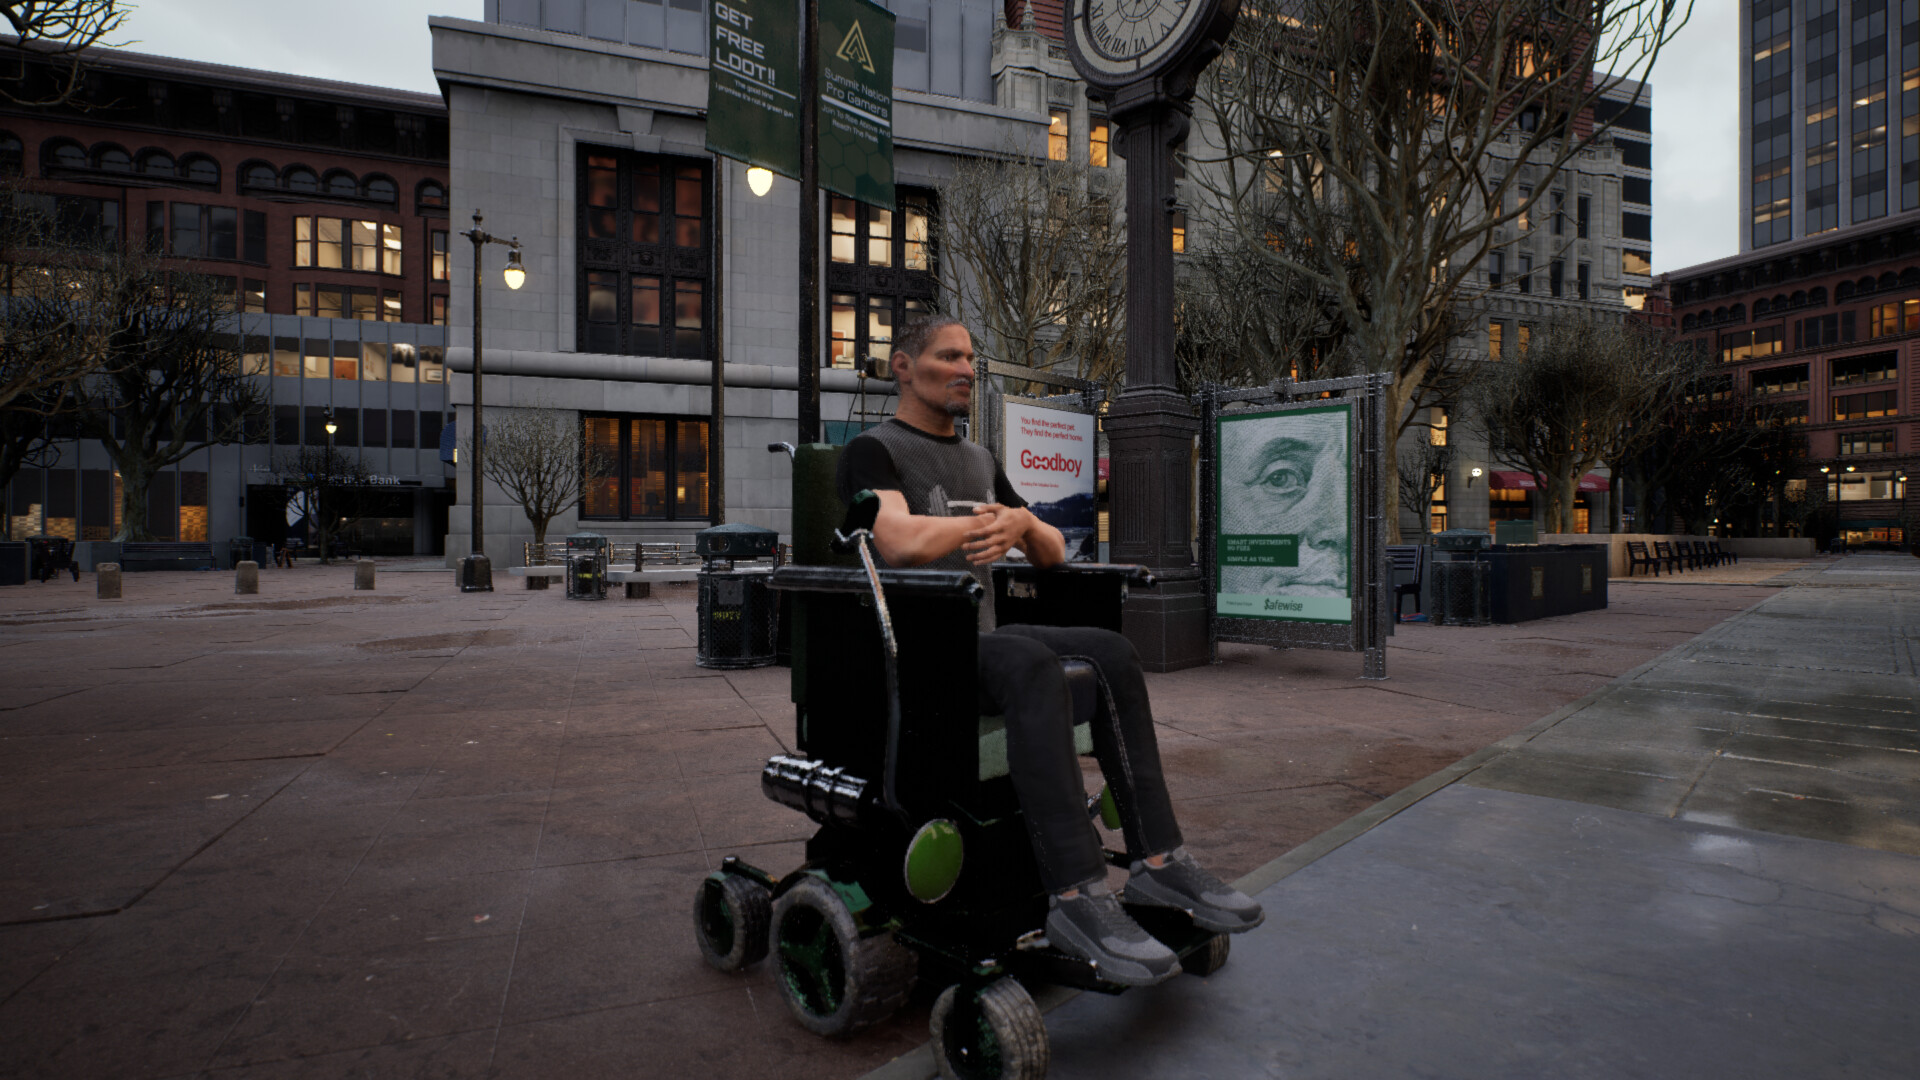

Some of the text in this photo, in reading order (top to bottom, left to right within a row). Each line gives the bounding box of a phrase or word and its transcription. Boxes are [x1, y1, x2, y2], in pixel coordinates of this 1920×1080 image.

[715, 1, 753, 30] GET
[716, 24, 765, 60] FREE
[716, 47, 775, 86] LOOT!!
[824, 67, 890, 104] Summit Nation
[826, 81, 888, 118] Pro Gamers
[821, 104, 836, 116] Join
[879, 127, 891, 139] And
[832, 118, 852, 133] Reach
[1020, 416, 1031, 425] You
[1031, 417, 1041, 426] find
[1041, 419, 1049, 427] the
[1050, 421, 1067, 430] perfect
[1020, 426, 1033, 437] They
[1034, 428, 1043, 437] find
[1044, 429, 1052, 438] the
[1052, 431, 1069, 440] perfect
[1020, 449, 1083, 478] Goodboy
[369, 474, 400, 486] Bank
